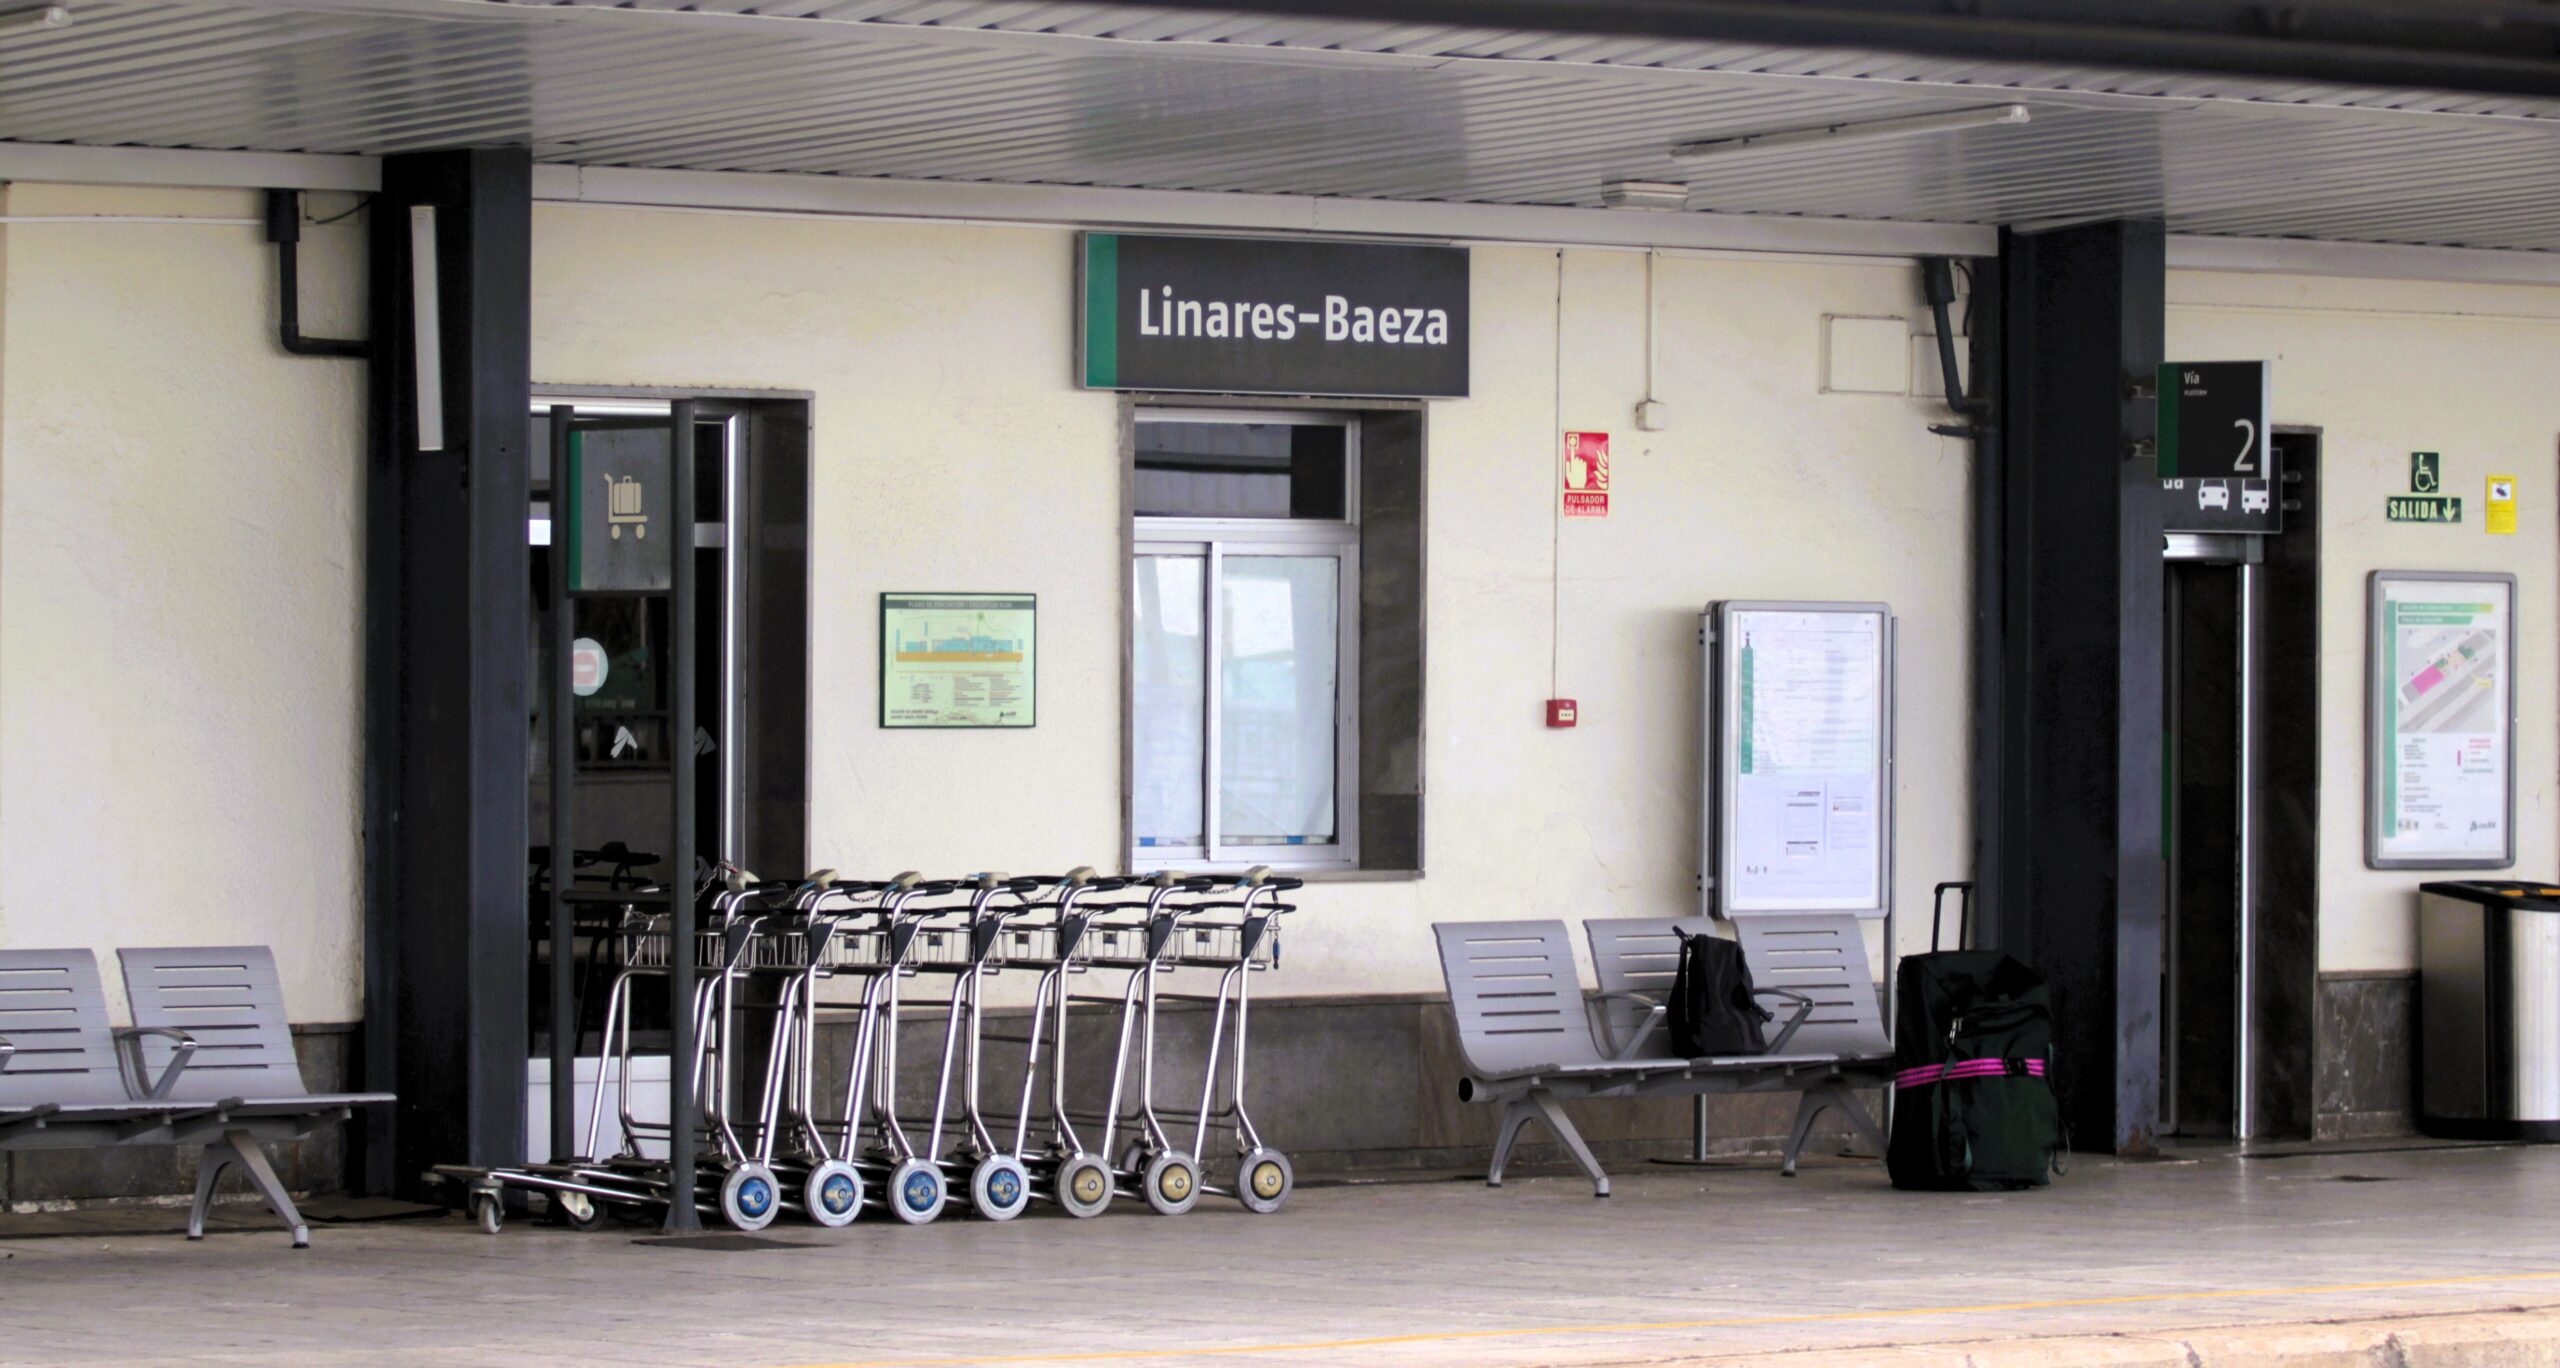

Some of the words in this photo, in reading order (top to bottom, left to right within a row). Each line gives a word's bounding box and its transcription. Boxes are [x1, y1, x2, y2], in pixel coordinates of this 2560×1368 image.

[1140, 285, 1448, 344] Linares-Baeza
[2184, 371, 2200, 384] Vía
[2234, 419, 2254, 472] 2
[1567, 495, 1605, 504] PULSADOR
[1565, 505, 1575, 514] DE
[1577, 505, 1606, 514] ALARMA
[2390, 501, 2437, 518] SALIDA
